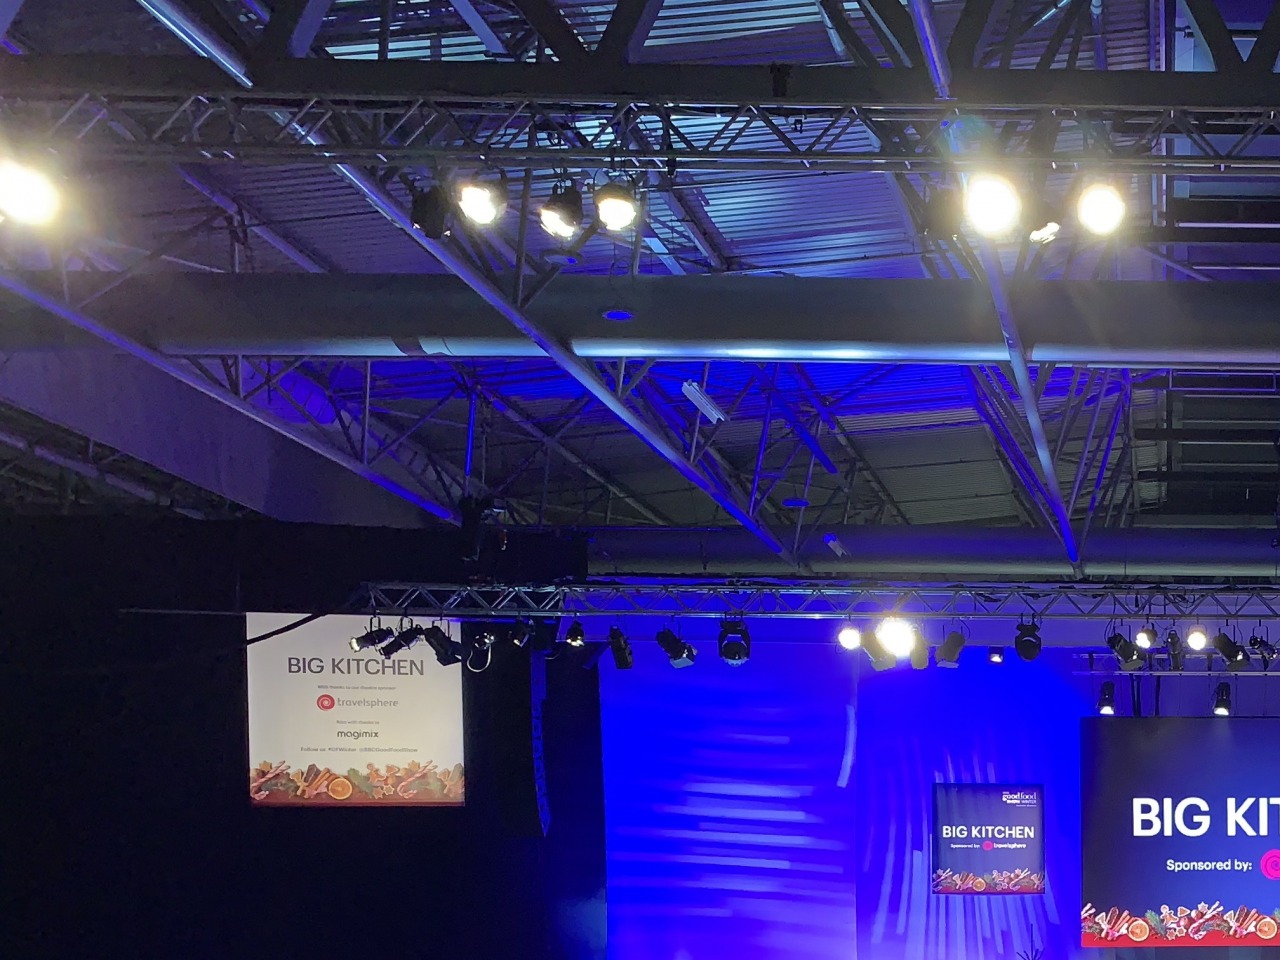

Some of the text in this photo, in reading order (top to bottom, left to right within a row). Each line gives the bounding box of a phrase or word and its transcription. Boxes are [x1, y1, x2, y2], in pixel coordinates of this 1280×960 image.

[288, 657, 424, 675] BIG KITCHEN
[338, 698, 398, 708] travelsphere
[337, 729, 379, 740] magimix
[1132, 797, 1211, 837] BIG
[942, 826, 1034, 838] BIG KITCHEN
[1166, 859, 1231, 872] Sponsored
[1234, 858, 1253, 872] by:
